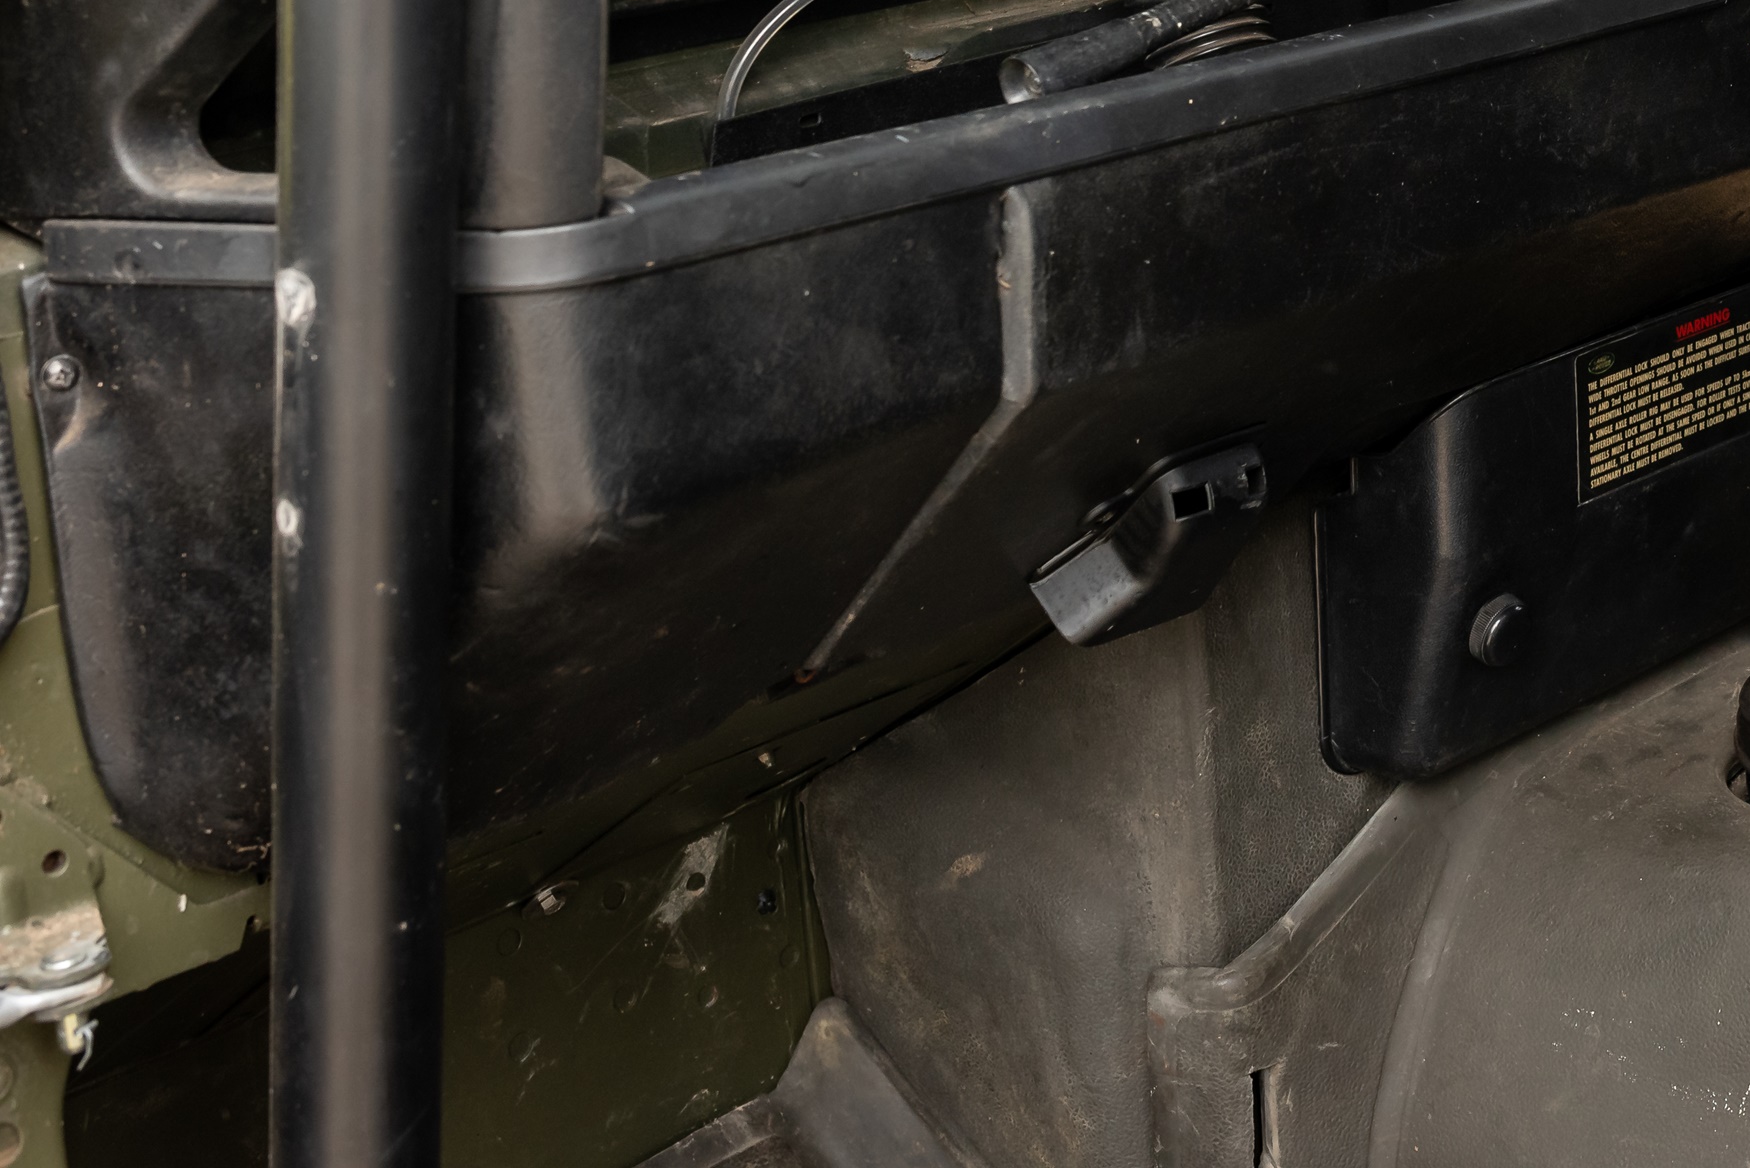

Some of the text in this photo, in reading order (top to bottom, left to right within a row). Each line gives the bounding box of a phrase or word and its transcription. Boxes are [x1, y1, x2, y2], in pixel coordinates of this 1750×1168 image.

[1676, 308, 1731, 338] WARNING
[1588, 380, 1597, 392] THE
[1600, 367, 1632, 388] DIFFERENTIAL
[1635, 361, 1648, 374] LOCK
[1650, 352, 1670, 368] SHOULD
[1672, 347, 1685, 360] ONLY
[1687, 344, 1693, 354] BE
[1695, 334, 1717, 351] ENGAGED
[1720, 328, 1734, 341] WHEN
[1588, 390, 1602, 404] WIDE
[1604, 380, 1628, 398] THROTTLE
[1629, 370, 1655, 388] OPENINGS
[1656, 361, 1676, 377] SHOULD
[1678, 359, 1684, 369] BE
[1686, 350, 1707, 366] AVOIDED
[1708, 343, 1723, 357] WHEN
[1725, 338, 1737, 351] USED
[1738, 335, 1744, 345] IN
[1598, 399, 1609, 412] AND
[1611, 395, 1621, 407] 2nd
[1623, 389, 1636, 403] GEAR
[1638, 384, 1650, 397] LOW
[1672, 372, 1678, 383] AS
[1680, 366, 1695, 380] SOON
[1696, 363, 1703, 374] AS
[1704, 359, 1713, 370] THE
[1715, 350, 1736, 366] DIFFICULT
[1589, 382, 1684, 428] DIFFERENTIAL LOCK MUST BE RELEASED.
[1589, 432, 1593, 441] A
[1596, 424, 1613, 439] SINGLE
[1615, 418, 1627, 431] AXLE
[1629, 410, 1647, 425] ROLLER
[1649, 406, 1658, 417] RIG
[1660, 400, 1671, 413] MAY
[1673, 397, 1679, 407] BE
[1681, 391, 1693, 404] USED
[1695, 387, 1705, 399] FOR
[1707, 379, 1723, 394] SPEEDS
[1725, 376, 1732, 386] UP
[1734, 373, 1740, 383] TO
[1590, 431, 1623, 453] DIFFERENTIAL
[1625, 425, 1638, 439] LOCK
[1640, 419, 1653, 433] MUST
[1655, 416, 1661, 426] BE
[1663, 402, 1695, 423] DISENGAGED.
[1697, 397, 1707, 410] FOR
[1709, 390, 1726, 405] ROLLER
[1728, 384, 1741, 397] TESTS
[1590, 449, 1610, 465] WHEELS
[1611, 442, 1625, 456] MUST
[1627, 439, 1633, 450] BE
[1635, 430, 1656, 446] ROTATED
[1658, 427, 1664, 437] AT
[1666, 422, 1675, 434] THE
[1677, 416, 1690, 429] SAME
[1692, 410, 1706, 423] SPEED
[1707, 406, 1715, 417] OR
[1717, 403, 1721, 413] IF
[1723, 397, 1735, 410] ONLY
[1737, 395, 1741, 405] A
[1620, 453, 1629, 465] THE
[1631, 445, 1649, 460] CENTRE
[1650, 431, 1682, 452] DIFFERENTIAL
[1684, 424, 1697, 438] MUST
[1699, 421, 1705, 432] BE
[1707, 413, 1724, 429] LOCKED
[1726, 408, 1737, 421] AND
[1739, 404, 1747, 415] THE
[1590, 442, 1683, 489] STATIONARY AXLE MUST BE REMOVED.
